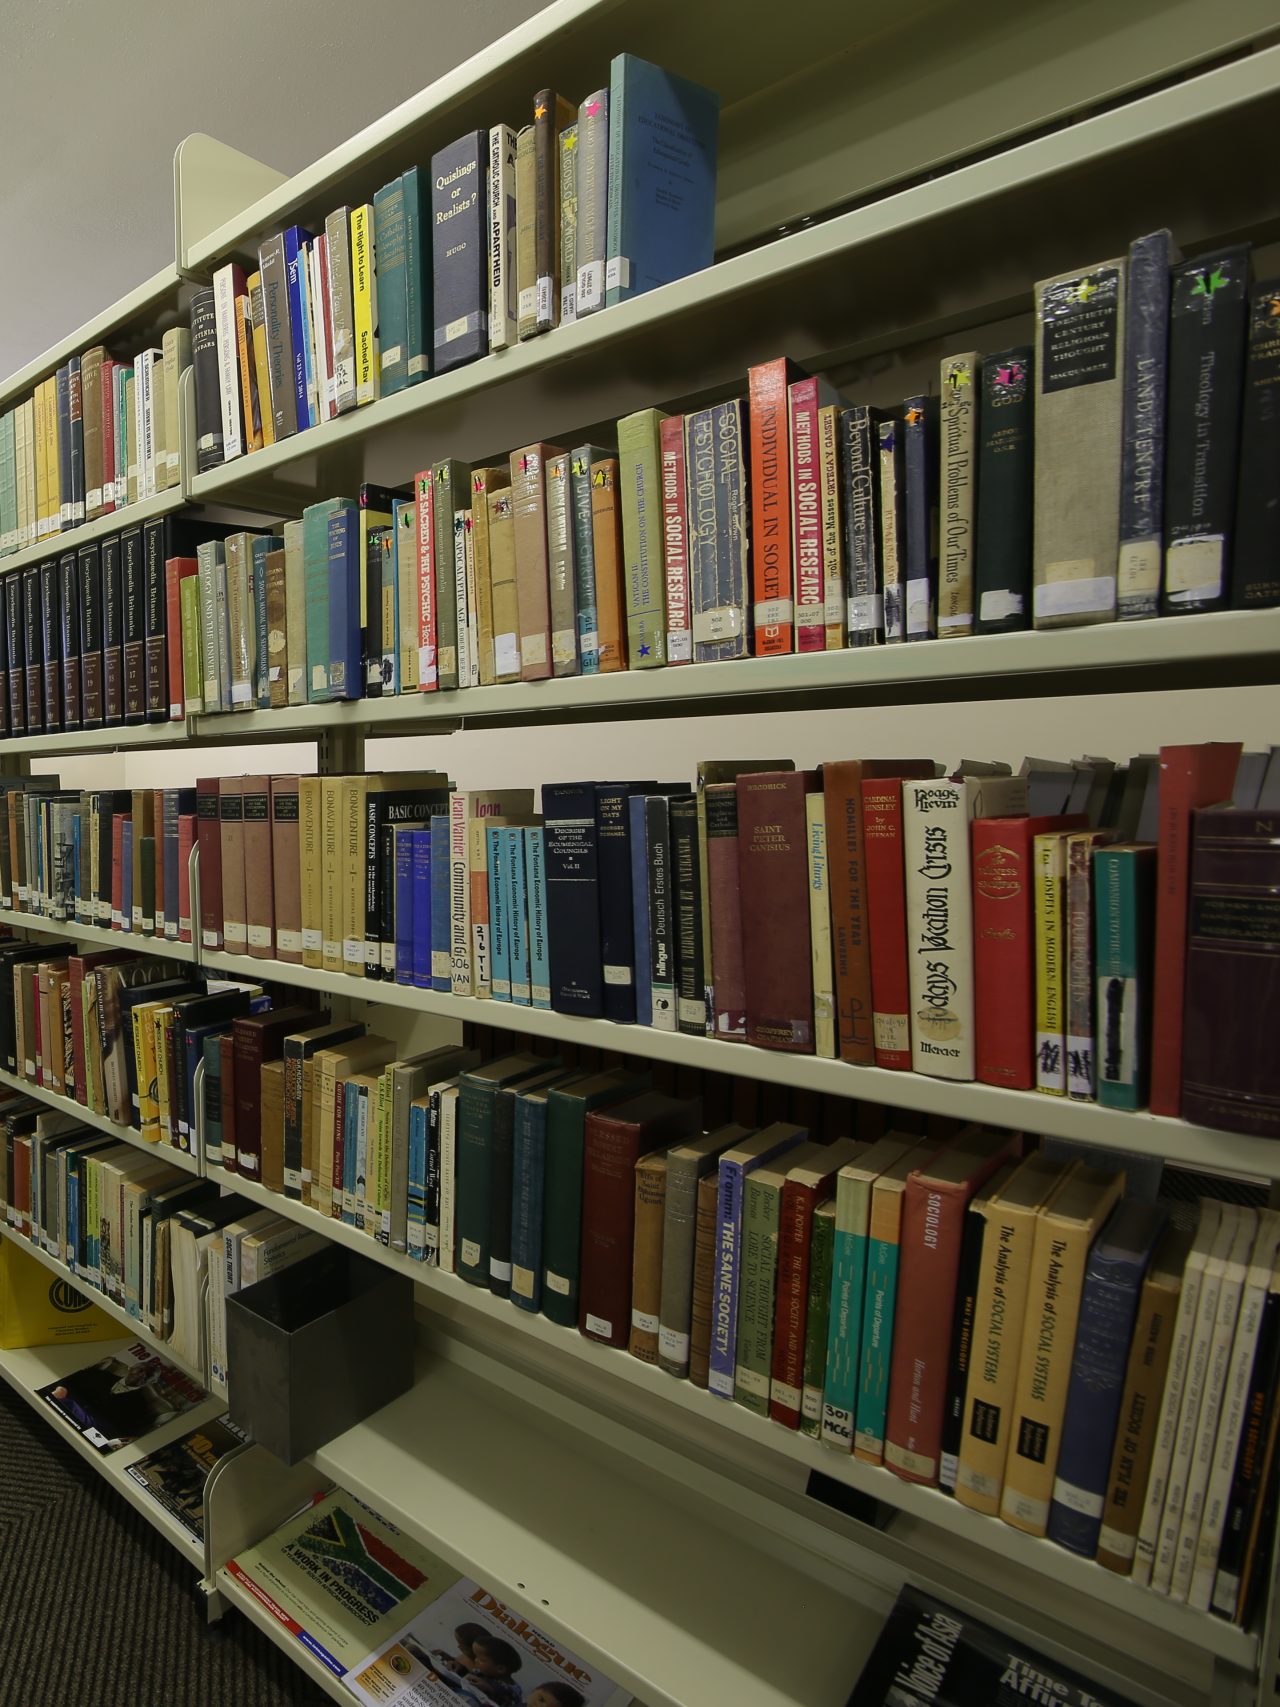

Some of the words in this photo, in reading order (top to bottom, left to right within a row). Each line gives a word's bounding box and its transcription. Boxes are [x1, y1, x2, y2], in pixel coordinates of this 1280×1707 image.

[492, 132, 500, 149] THE
[436, 159, 477, 190] Quislings
[492, 151, 501, 181] CATHOLIC
[451, 187, 462, 199] or
[493, 183, 502, 208] CHURCH
[354, 207, 365, 231] The
[357, 232, 367, 258] Right
[446, 243, 467, 258] HUGO
[493, 222, 502, 287] APARTHEID
[358, 270, 366, 292] Learn
[269, 281, 281, 342] Personality
[1050, 331, 1111, 352] RELIGIOUS
[1054, 321, 1106, 340] CENTURY
[273, 343, 284, 388] Theories
[1053, 344, 1107, 363] THOUGHT
[1194, 351, 1216, 418] Theology
[718, 412, 738, 484] SOCIAL
[795, 411, 812, 465] METHODS
[823, 414, 833, 447] GASSET
[846, 419, 865, 471] Beyond
[943, 406, 967, 457] Spiritual
[663, 452, 678, 500] METHODS
[760, 405, 780, 512] INDIVIDUAL
[635, 463, 645, 496] CHURCH
[697, 420, 717, 546] PSYCHOLOGY
[825, 459, 836, 496] ORTEGA
[946, 459, 969, 511] Problems
[1192, 440, 1212, 517] Transition
[798, 483, 817, 537] SOCIAL
[826, 498, 837, 529] Masses
[851, 475, 870, 531] Culture
[419, 502, 430, 545] SACRED
[666, 516, 683, 563] SOCIAL
[763, 517, 779, 540] IN
[947, 526, 969, 550] Our
[202, 546, 213, 595] THEOLOGY
[455, 542, 466, 606] APOCALYPTIC
[639, 529, 650, 591] CONSTITUTION
[946, 549, 969, 584] Times
[421, 575, 432, 624] PSYCHIC
[631, 574, 640, 607] VATICAN
[388, 804, 414, 820] BASIC
[452, 796, 466, 820] Jean
[600, 798, 622, 806] LIGHT
[602, 811, 620, 819] DAYS
[863, 795, 897, 804] CARDINAL
[864, 803, 897, 811] HINSLEY
[305, 790, 314, 855] BONAVENTURE
[327, 789, 336, 856] BONAVENTURE
[349, 788, 358, 857] BONAVENTURE
[453, 821, 466, 856] Vanier
[752, 834, 787, 843] PETER
[753, 824, 782, 835] SAINT
[811, 822, 825, 856] Living
[845, 798, 858, 853] HOMILIES
[653, 842, 665, 865] Buch
[749, 842, 791, 853] CANISIUS
[917, 825, 952, 880] Crisis
[654, 867, 665, 894] Erstes
[813, 855, 826, 891] Liturgy
[847, 860, 859, 882] FOR
[454, 862, 468, 923] Community
[848, 888, 860, 910] THE
[655, 898, 667, 934] Deutsch
[851, 917, 862, 946] YEAR
[917, 886, 956, 955] Vocation
[455, 925, 467, 944] and
[838, 926, 849, 977] LAWRENCE
[451, 957, 470, 970] 306
[1044, 938, 1058, 981] MODERN
[451, 974, 470, 986] VAN
[1045, 987, 1058, 1031] ENGLISH
[919, 1041, 961, 1058] Mercier
[722, 1165, 738, 1220] Fromm:
[721, 1221, 736, 1249] THE
[793, 1214, 804, 1244] POPPER
[923, 1193, 942, 1250] SOCIOLOGY
[998, 1225, 1015, 1243] The
[748, 1231, 759, 1259] LORE
[759, 1234, 772, 1273] SOCIAL
[1051, 1239, 1068, 1258] The
[718, 1251, 734, 1290] SANE
[993, 1245, 1012, 1285] Analysis
[1044, 1259, 1064, 1300] Analysis
[744, 1278, 757, 1323] SCIENCE
[791, 1273, 801, 1295] OPEN
[992, 1286, 1006, 1298] of
[757, 1277, 770, 1328] THOUGHT
[789, 1297, 800, 1330] SOCIETY
[987, 1298, 1004, 1336] SOCIAL
[1043, 1302, 1058, 1313] of
[715, 1293, 732, 1356] SOCIETY
[871, 1316, 883, 1349] Departure
[1038, 1314, 1057, 1353] SOCIAL
[127, 1342, 151, 1361] The
[755, 1329, 768, 1361] FROM
[983, 1338, 1001, 1385] SYSTEMS
[1031, 1355, 1051, 1402] SYSTEMS
[824, 1404, 850, 1420] 301
[293, 1548, 324, 1579] WORK
[319, 1569, 333, 1584] IN
[330, 1578, 380, 1625] PROGRESS
[319, 1580, 343, 1603] AFRICAN
[339, 1597, 373, 1627] DEMOCRACY
[470, 1586, 593, 1683] Dialogue
[893, 1651, 946, 1700] Voice
[1007, 1652, 1070, 1697] Time
